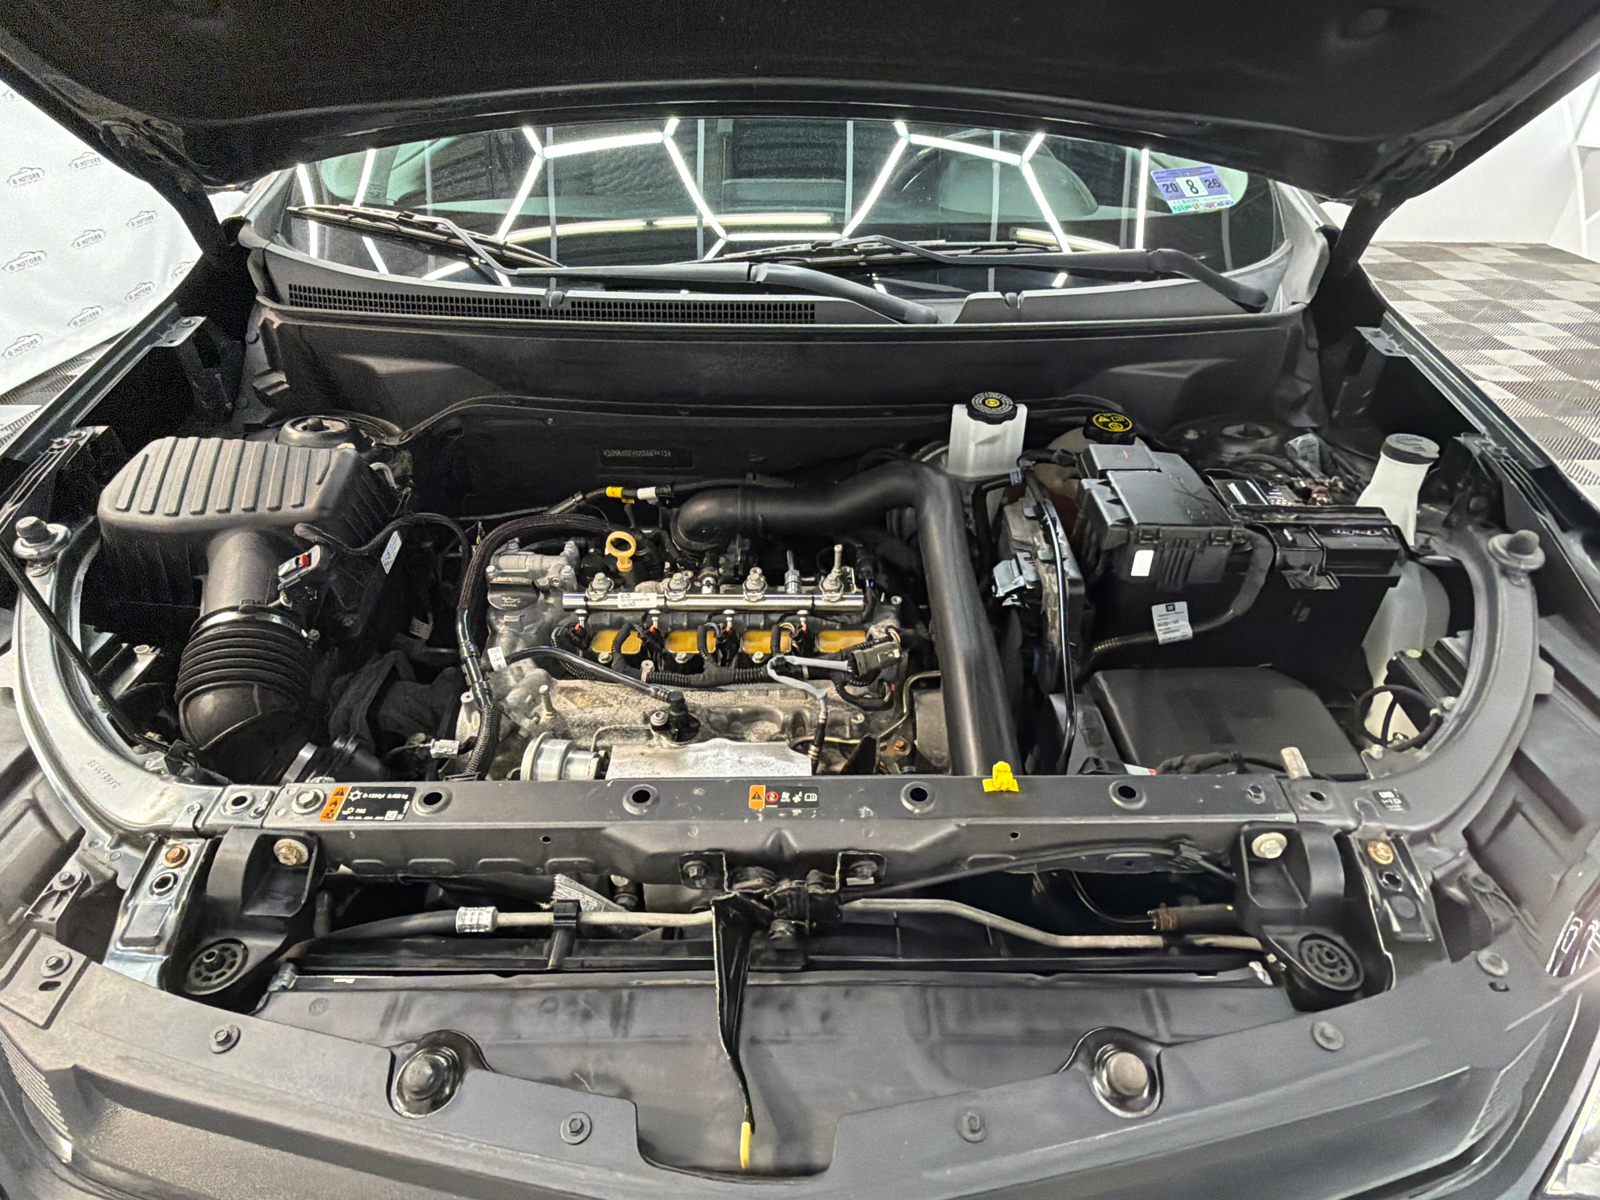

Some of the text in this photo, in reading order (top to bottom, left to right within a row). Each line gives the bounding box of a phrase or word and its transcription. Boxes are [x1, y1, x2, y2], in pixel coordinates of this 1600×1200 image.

[1162, 178, 1221, 194] 20 8 26
